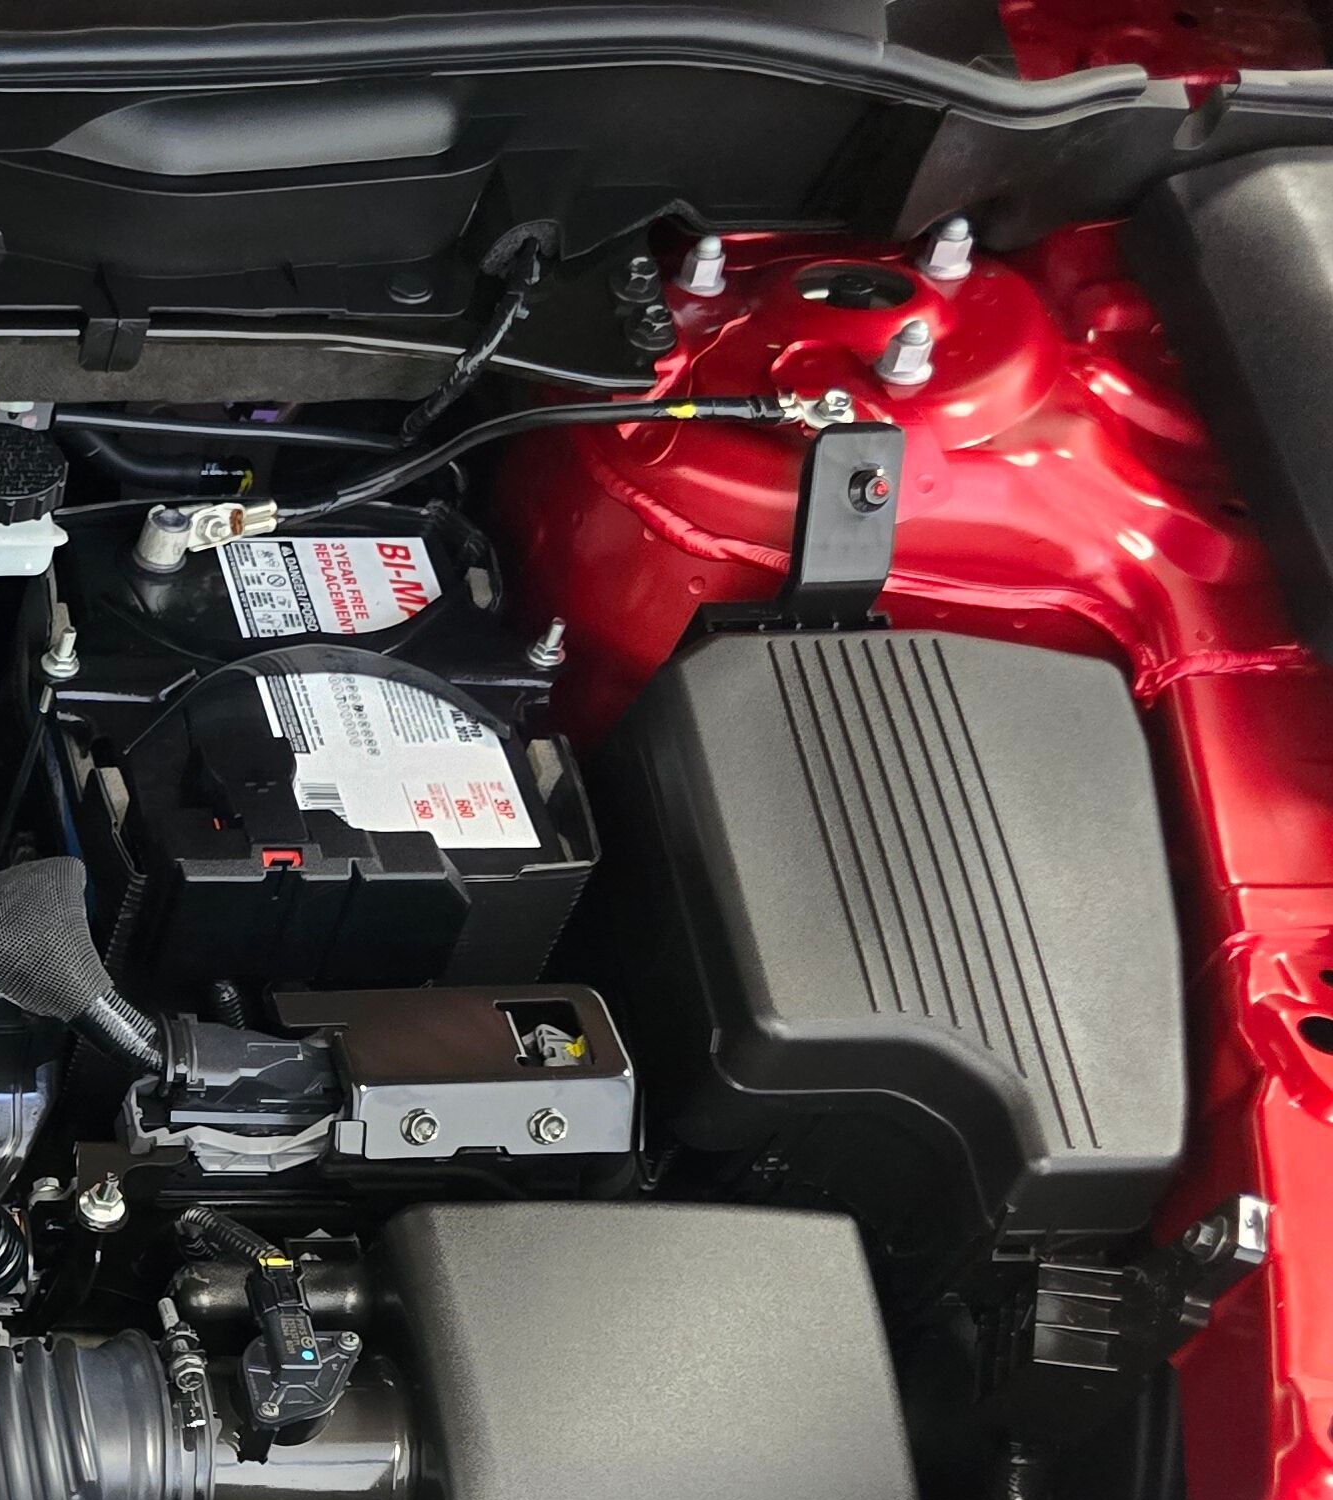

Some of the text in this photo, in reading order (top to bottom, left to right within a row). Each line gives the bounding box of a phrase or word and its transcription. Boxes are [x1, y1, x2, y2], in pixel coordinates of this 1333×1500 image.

[312, 543, 357, 636] REPLACEMENT
[334, 552, 357, 586] YEAR
[347, 588, 371, 620] FREE
[454, 799, 476, 819] 660
[493, 798, 517, 821] 35P
